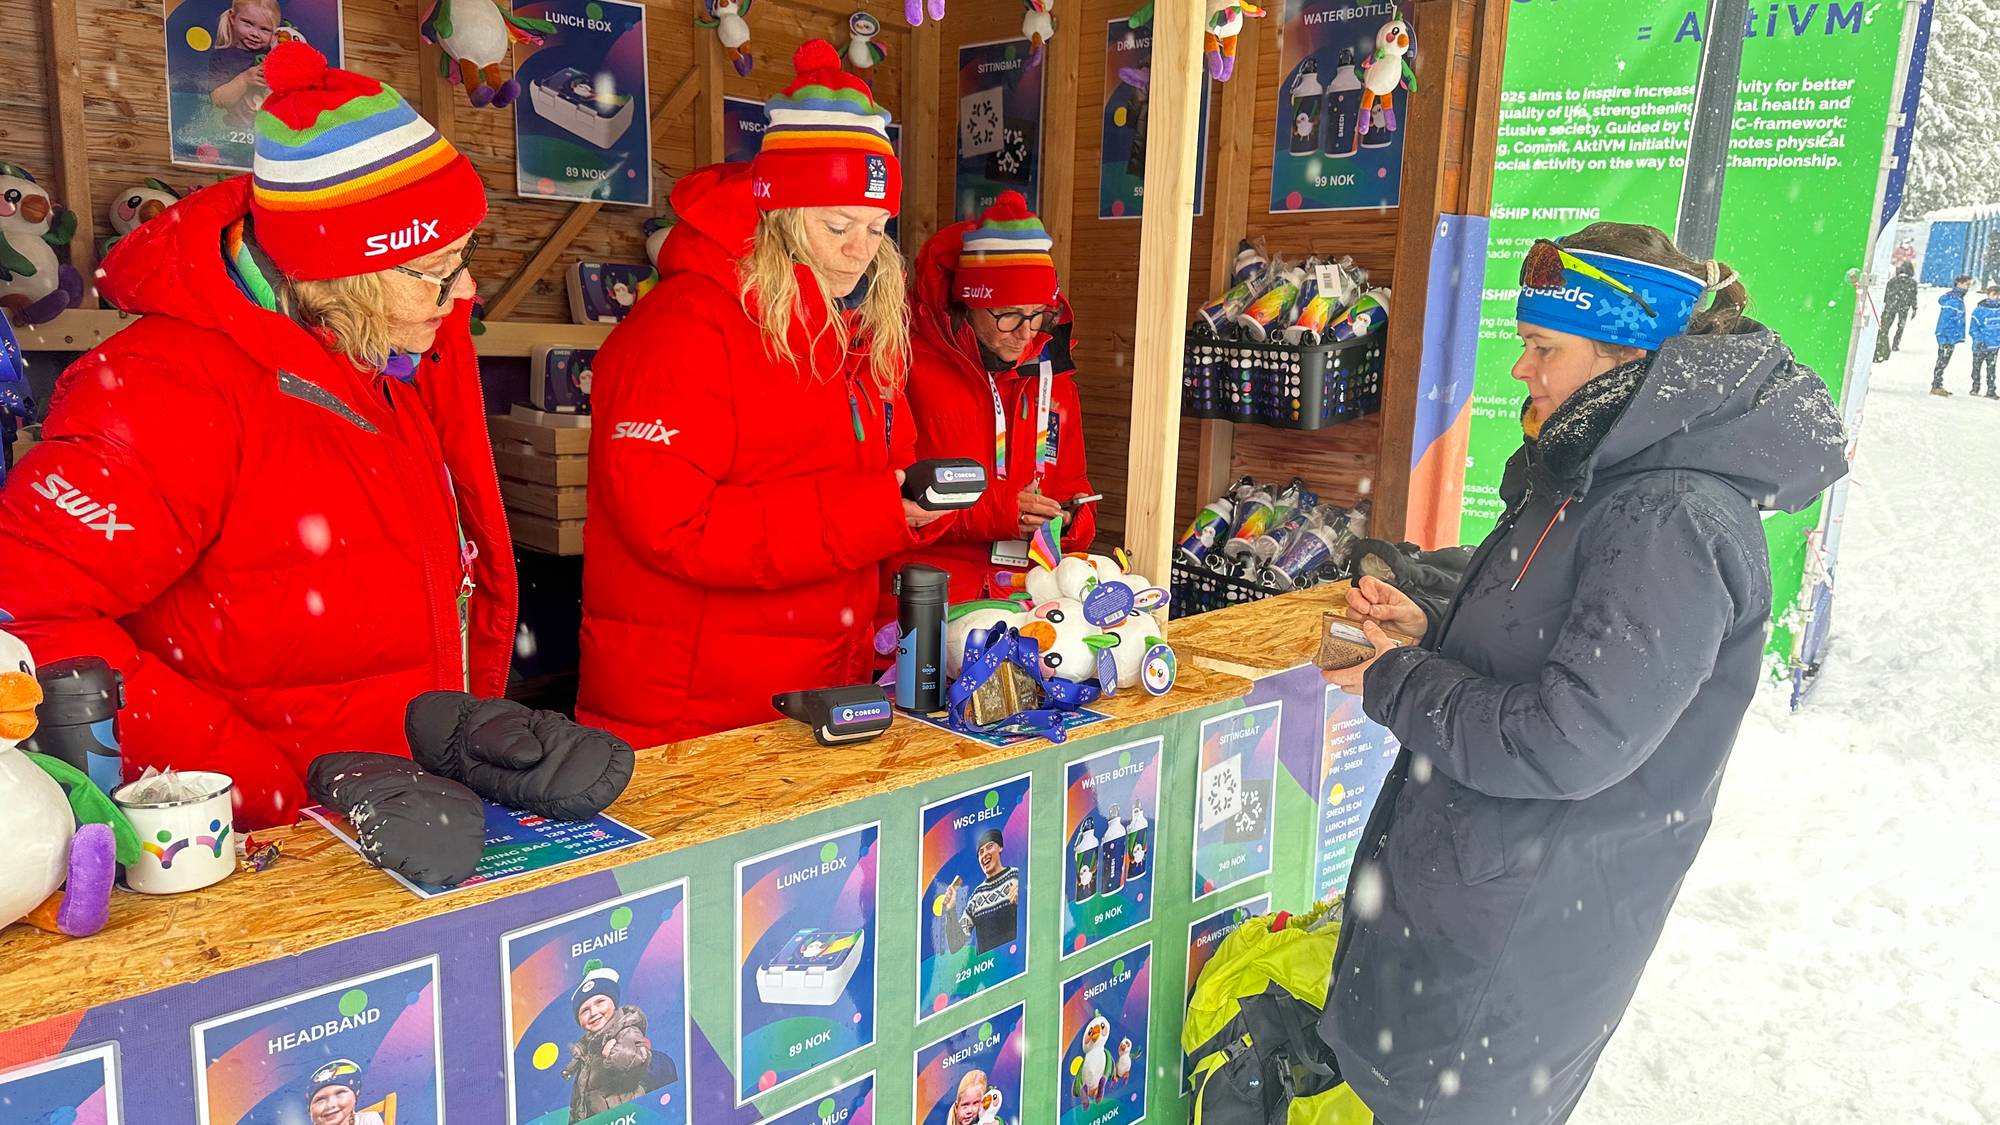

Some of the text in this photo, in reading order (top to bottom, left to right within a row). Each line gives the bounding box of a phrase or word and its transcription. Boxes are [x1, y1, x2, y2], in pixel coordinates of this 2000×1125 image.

[545, 11, 612, 33] LUNCH BOX
[1304, 4, 1392, 25] WATER BOTTLE
[1674, 2, 1864, 43] AtiVM
[1117, 37, 1153, 52] DRAWS
[977, 59, 1022, 74] SITTINGMAT
[1501, 90, 1526, 103] 025
[1528, 89, 1562, 102] aims
[1566, 90, 1580, 101] to
[1583, 86, 1631, 102] inspire
[1635, 85, 1695, 98] increase
[1776, 79, 1799, 92] for
[1802, 78, 1855, 92] better
[1547, 106, 1562, 119] of
[1762, 97, 1815, 111] health
[1819, 96, 1852, 110] and
[1549, 122, 1602, 138] society.
[1606, 120, 1660, 134] Guided
[1663, 121, 1680, 133] by
[230, 131, 255, 145] 229
[1513, 141, 1570, 155] Commit,
[1573, 139, 1626, 153] AktiVM
[1776, 134, 1845, 152] physical
[1533, 157, 1585, 172] activity
[1588, 158, 1606, 170] on
[1610, 156, 1633, 169] the
[1636, 156, 1666, 172] way
[1669, 155, 1684, 168] to
[566, 166, 608, 180] 89 NOK
[1314, 174, 1355, 187] 99 NOK
[1133, 186, 1144, 197] 59
[1532, 207, 1600, 220] KNITTING
[854, 708, 881, 717] COREGO
[1219, 725, 1260, 746] SITTINGMAT
[1343, 746, 1357, 757] WSC
[1358, 742, 1373, 754] BELL
[1081, 762, 1145, 790] WATER BOTTLE
[953, 806, 1003, 831] WSC BELL
[1325, 819, 1346, 833] LUNCH
[567, 822, 598, 833] NOK
[521, 841, 551, 852] BAG
[583, 833, 614, 845] NOK
[598, 838, 630, 849] NOK
[1324, 834, 1346, 848] WATER
[494, 856, 528, 867] MUG
[1232, 854, 1247, 868] NOK
[776, 857, 848, 891] LUNCH BOX
[1094, 905, 1123, 925] 99 NOK
[571, 927, 628, 958] BEANIE
[955, 958, 995, 984] 229 NOK
[1083, 970, 1131, 1001] SNEDI 15 CM
[268, 1007, 381, 1056] HEADBAND
[789, 1030, 831, 1058] 89 NOK
[942, 1033, 1000, 1070] SNEDI 30 CM
[822, 1108, 848, 1125] MUG
[1102, 1106, 1119, 1124] NOK
